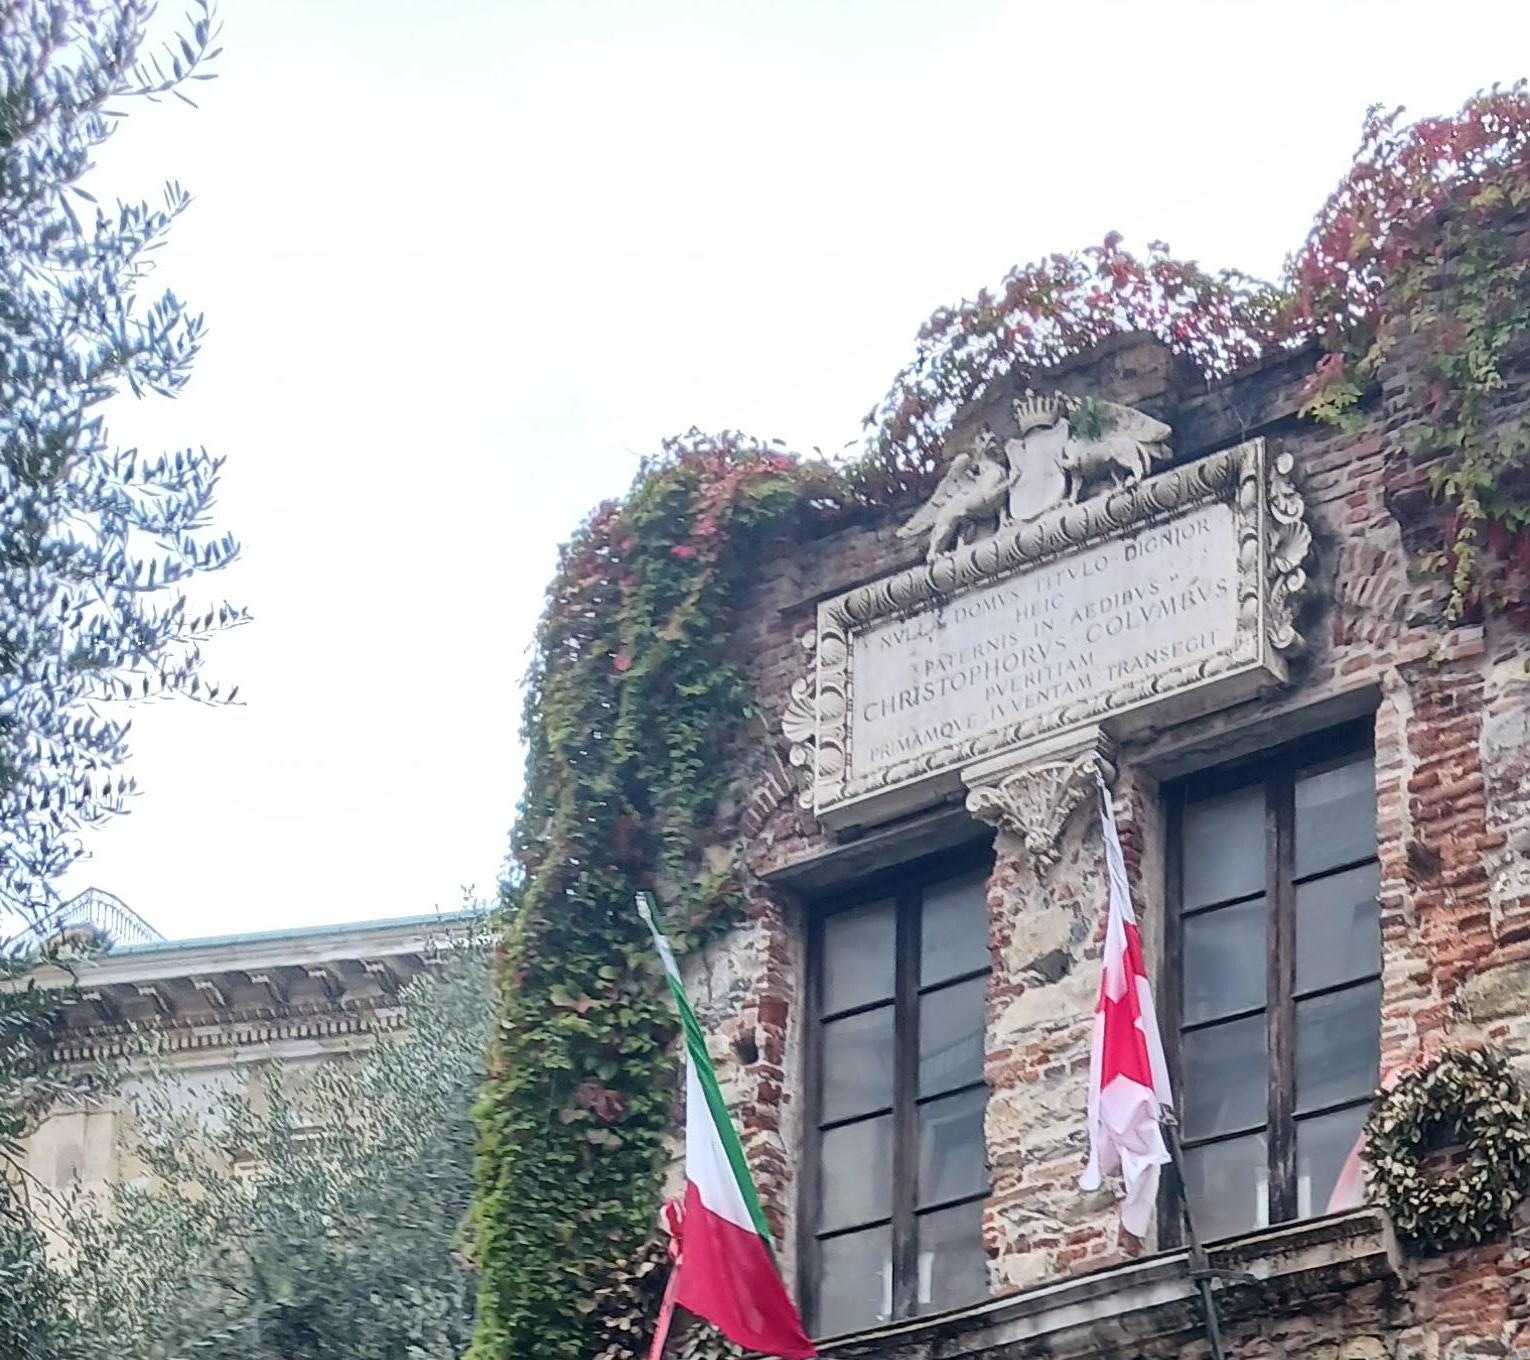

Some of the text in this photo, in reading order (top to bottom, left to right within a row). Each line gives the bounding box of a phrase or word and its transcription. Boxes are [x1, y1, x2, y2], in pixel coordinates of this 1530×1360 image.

[954, 590, 1019, 624] DOMVS
[1036, 555, 1108, 592] TITVLO
[1125, 518, 1209, 561] DIGNIOR
[1017, 593, 1063, 622] HEIC
[864, 577, 1227, 722] CHRISTOPHORVS COLVMBVS
[926, 580, 1159, 676] PATERNIS IN AEDIBVS
[986, 651, 1093, 701] PVERITIAM
[869, 629, 1216, 761] PRIMAMQVE IVVENTAM TRANSEGIT
